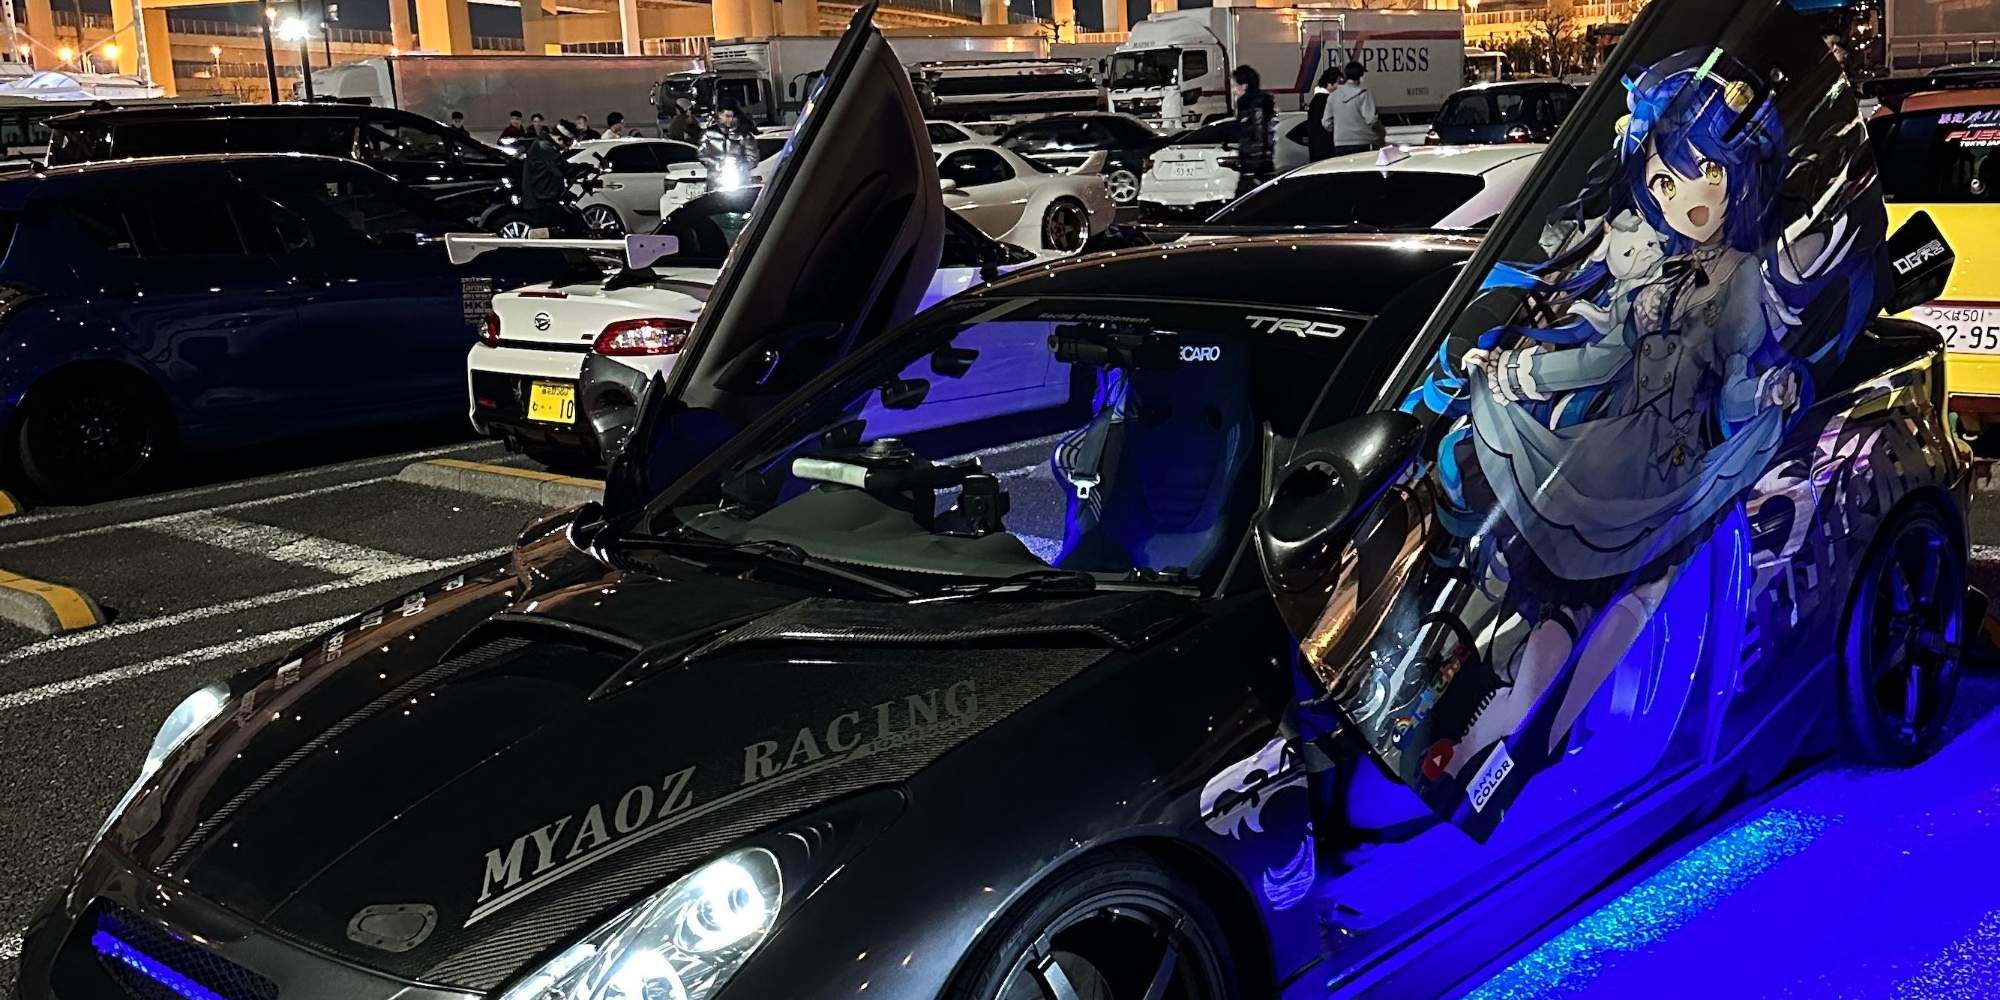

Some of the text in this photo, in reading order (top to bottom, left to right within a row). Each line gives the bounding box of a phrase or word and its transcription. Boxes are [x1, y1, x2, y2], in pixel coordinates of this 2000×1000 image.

[1245, 314, 1347, 339] TRD
[1935, 324, 2000, 350] 2-95
[476, 678, 980, 904] MYAOZ RACING
[1473, 767, 1493, 800] ANY
[1475, 759, 1511, 807] COLOR
